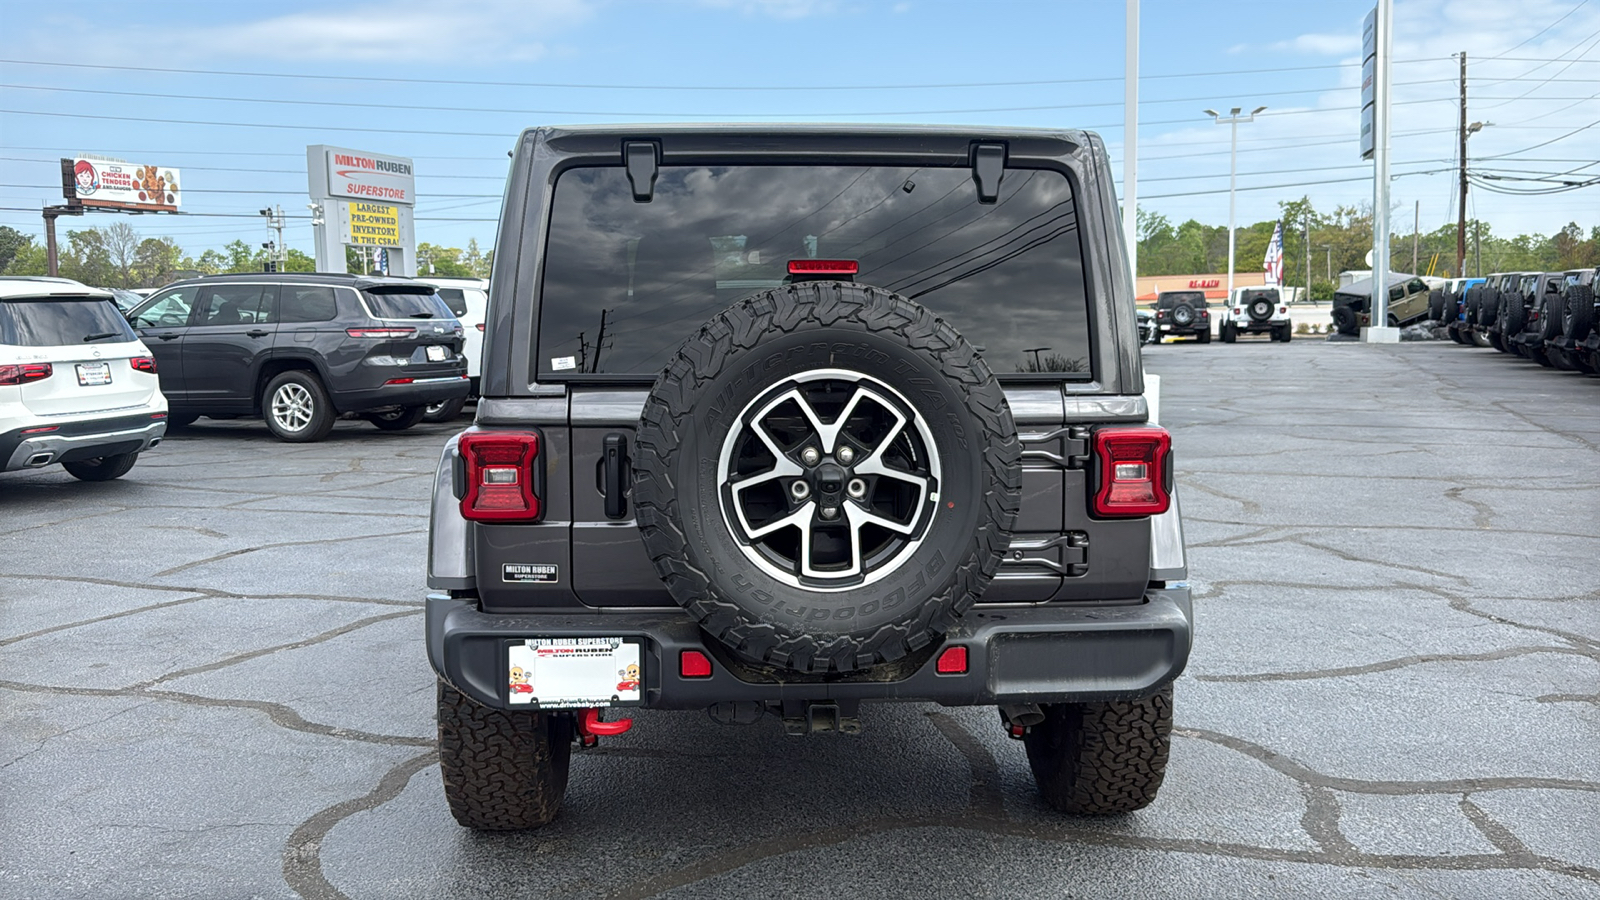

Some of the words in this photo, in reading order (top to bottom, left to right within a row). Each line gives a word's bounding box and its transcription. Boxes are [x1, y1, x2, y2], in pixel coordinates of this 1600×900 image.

[335, 154, 375, 169] MILTON
[376, 160, 411, 175] RUBEN
[101, 171, 131, 179] CHICKEN
[102, 178, 131, 186] TENDERS
[347, 183, 405, 199] SUPERSTORE
[356, 203, 391, 214] LARGEST
[351, 213, 396, 225] PRE-OWNED
[352, 224, 396, 236] INVENTORY
[361, 236, 377, 245] THE
[702, 340, 892, 437] All-Terrain
[505, 565, 532, 573] MILTON
[532, 566, 556, 574] RUBEN
[729, 548, 948, 623] BFGoodrich
[524, 638, 551, 647] MILTON
[552, 638, 577, 646] RUBEN
[578, 637, 624, 646] SUPERSTORE
